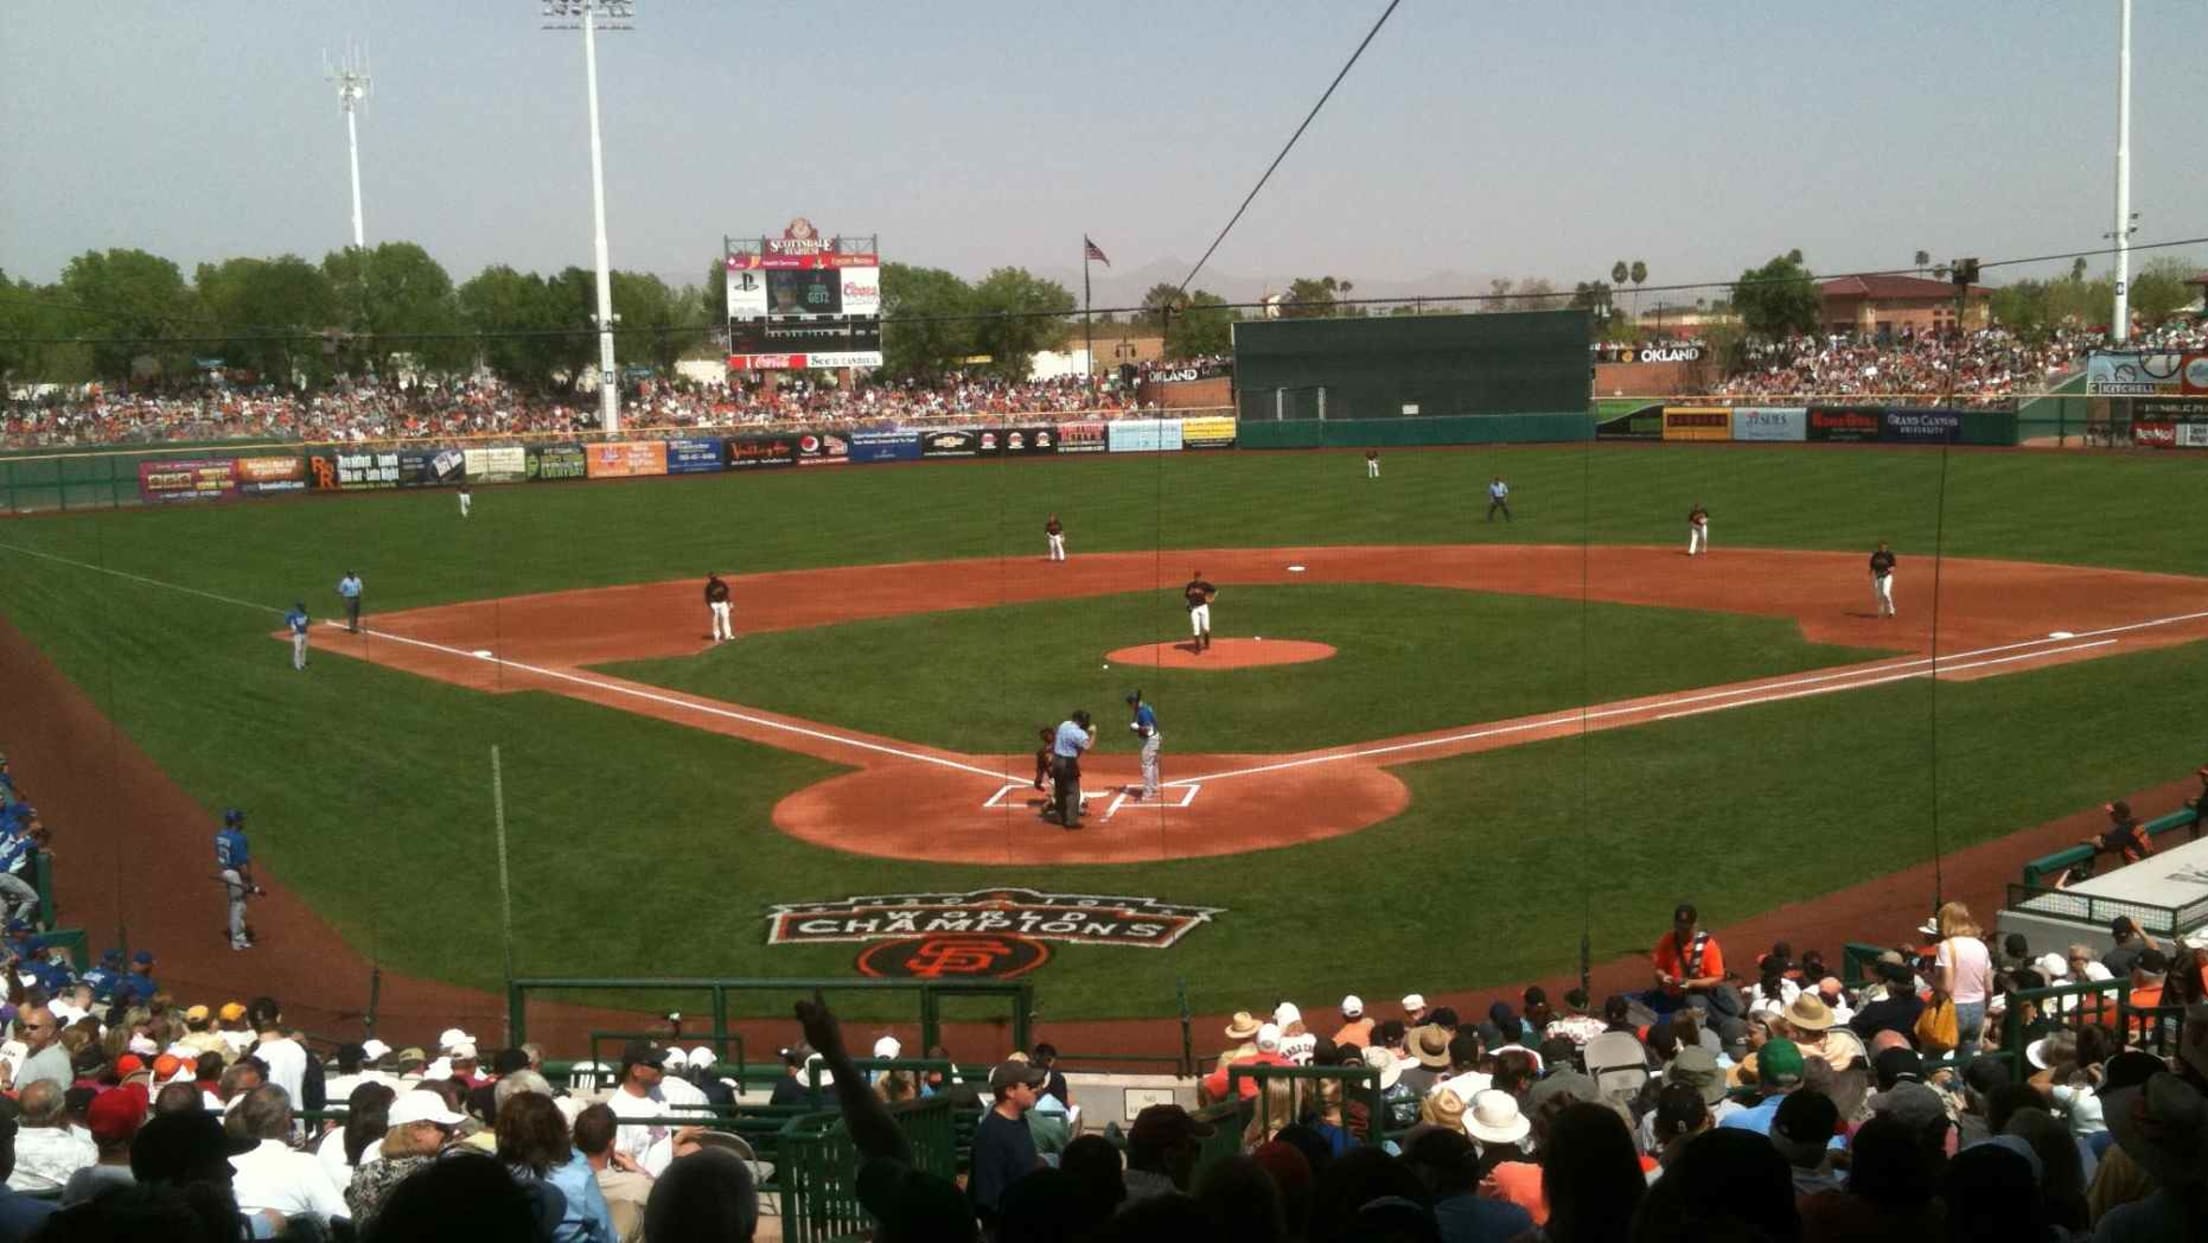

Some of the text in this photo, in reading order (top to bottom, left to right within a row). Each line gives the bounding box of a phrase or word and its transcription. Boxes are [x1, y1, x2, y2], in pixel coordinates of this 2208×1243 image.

[1641, 348, 1699, 362] OKLAND
[1888, 413, 1919, 426] GRAND
[886, 911, 1088, 921] WORLD
[797, 918, 1165, 938] CHAMPIONS
